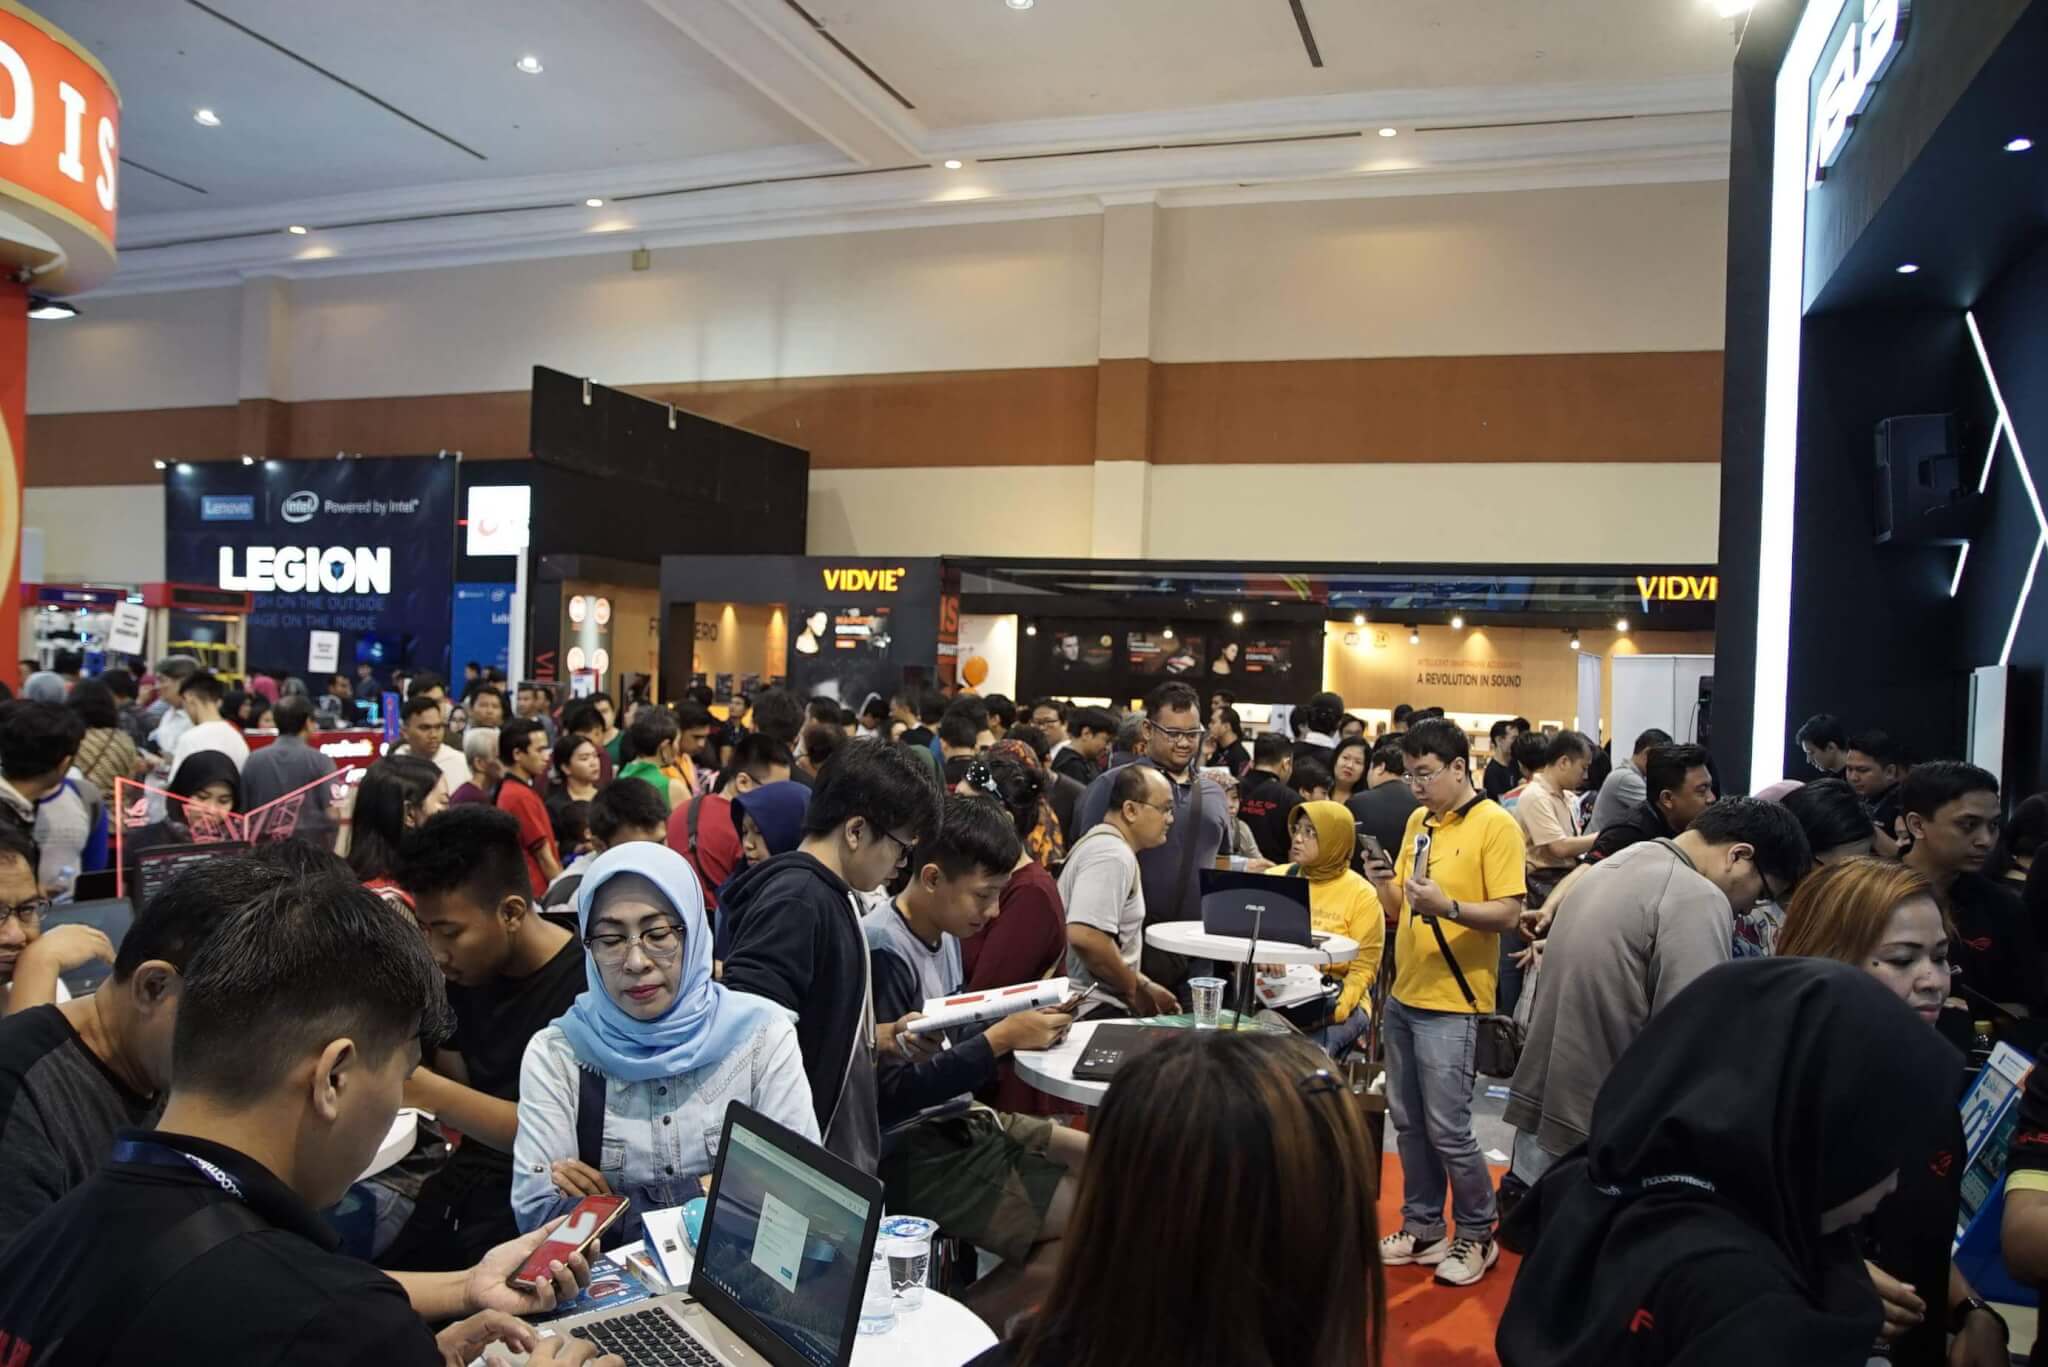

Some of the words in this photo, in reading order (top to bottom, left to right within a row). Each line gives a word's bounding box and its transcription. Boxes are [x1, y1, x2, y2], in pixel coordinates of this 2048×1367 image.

[205, 499, 250, 514] Lenovo
[324, 499, 372, 513] Powered
[375, 500, 386, 516] by
[219, 546, 391, 594] LEGION
[824, 568, 900, 592] VIDVIE
[1637, 576, 1718, 601] VIDVI
[1417, 672, 1424, 685] A
[1425, 672, 1478, 687] REVOLUTION
[1480, 674, 1489, 687] IN
[1491, 674, 1522, 688] SOUND
